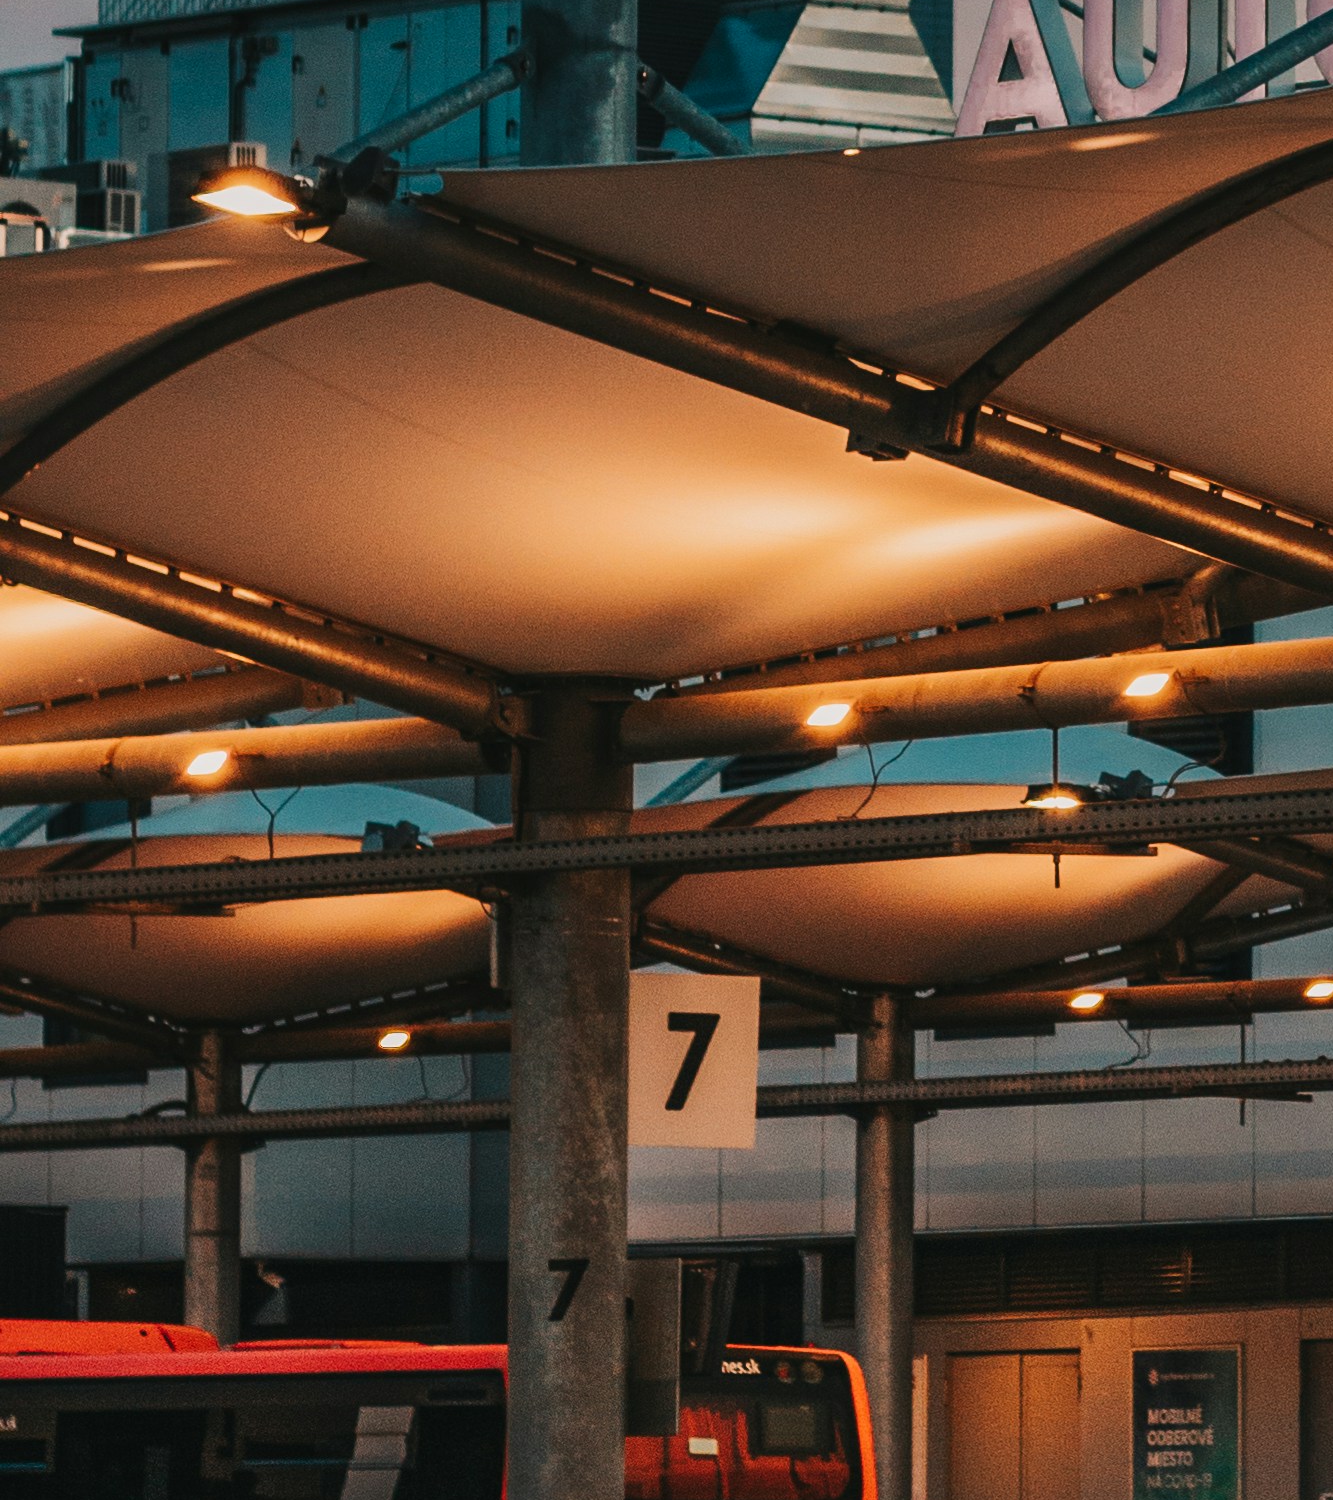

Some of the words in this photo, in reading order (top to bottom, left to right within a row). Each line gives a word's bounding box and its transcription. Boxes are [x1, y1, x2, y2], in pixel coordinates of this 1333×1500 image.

[665, 1011, 720, 1111] 7
[548, 1259, 590, 1321] 7
[721, 1358, 761, 1375] nes.sk
